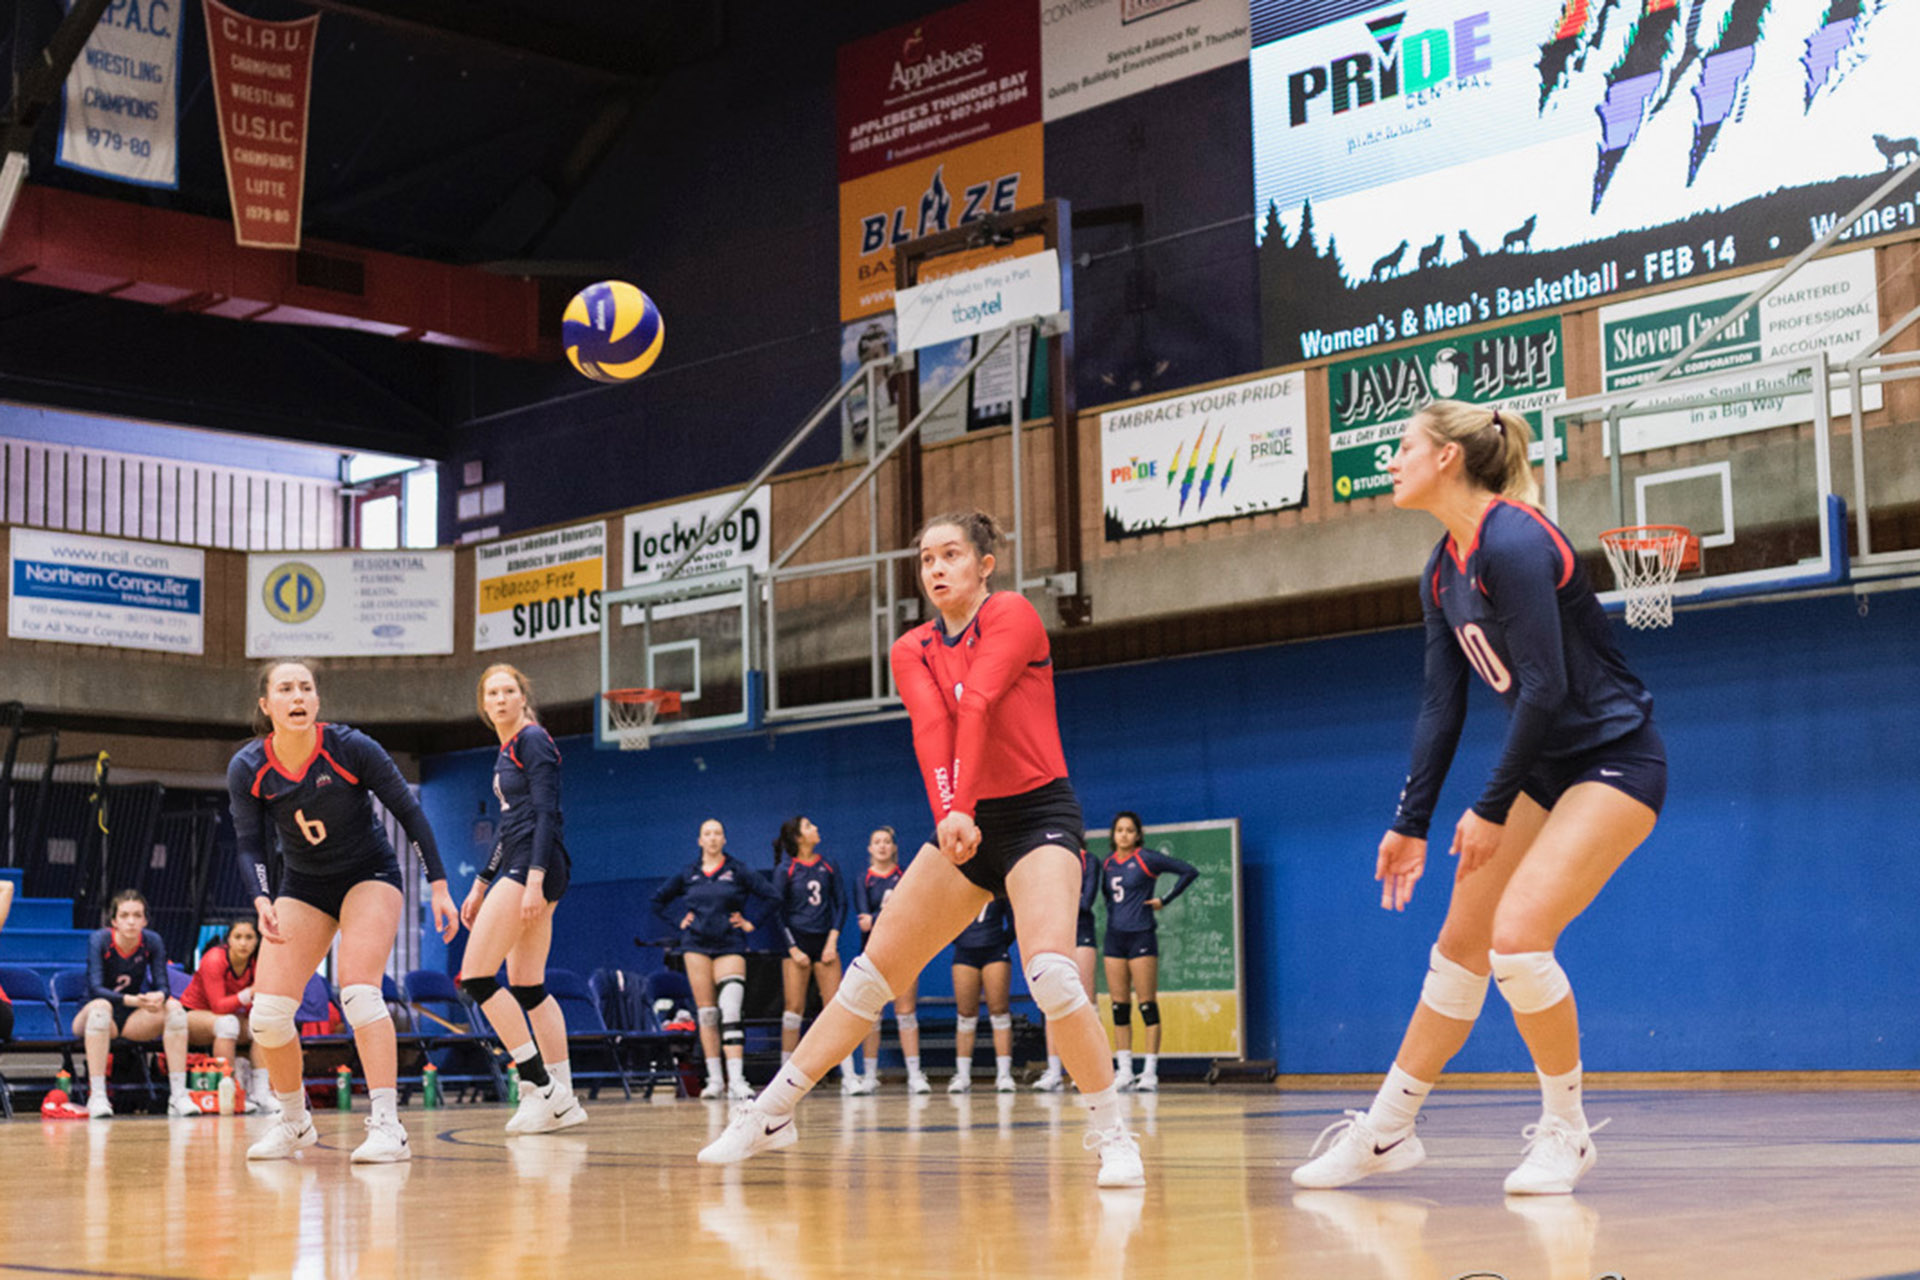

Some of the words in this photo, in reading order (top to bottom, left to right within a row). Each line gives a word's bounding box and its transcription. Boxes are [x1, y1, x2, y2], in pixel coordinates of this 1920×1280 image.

[1106, 47, 1142, 64] Service
[1144, 31, 1184, 52] Alliance
[1186, 24, 1200, 38] for
[85, 47, 163, 84] WRESTLING
[230, 53, 293, 79] CHAMPIONS
[1048, 81, 1079, 99] Quality
[1081, 67, 1120, 88] Building
[1122, 46, 1190, 74] Environments
[1193, 40, 1203, 51] in
[1205, 26, 1248, 47] Thunder
[1288, 11, 1492, 128] PRIDE
[84, 86, 159, 121] CHAMPIONS
[231, 82, 295, 109] WRESTLING
[931, 81, 998, 112] THUNDER
[1000, 70, 1028, 91] BAY
[86, 130, 151, 158] 1979-80
[872, 126, 907, 147] ALLOY
[908, 113, 943, 135] DRIVE
[233, 147, 295, 171] CHAMPIONS
[245, 177, 286, 199] LUTTE
[861, 163, 1021, 257] BLAZE
[952, 291, 1003, 325] tbaytel
[1300, 313, 1396, 360] Women's
[1400, 307, 1419, 337] &
[1423, 291, 1491, 333] Men's
[1496, 259, 1620, 317] Basketball
[1643, 245, 1695, 284] FEB
[1701, 235, 1737, 269] 14
[1767, 280, 1851, 308] CHARTERED
[1769, 303, 1873, 333] PROFESSIONAL
[1613, 325, 1684, 363] Steven
[1770, 329, 1862, 357] ACCOUNTANT
[1335, 354, 1434, 425] JAVA
[1473, 329, 1557, 398] HUT
[1684, 352, 1753, 374] CORPORATION
[1108, 401, 1184, 432] EMBRACE
[1190, 390, 1238, 414] YOUR
[1241, 379, 1292, 404] PRIDE
[1691, 410, 1705, 424] in
[1722, 400, 1748, 418] Big
[1250, 437, 1293, 462] PRIDE
[1335, 431, 1352, 446] ALL
[1355, 428, 1375, 443] DAY
[1111, 456, 1157, 484] PRIDE
[561, 525, 603, 543] University
[51, 547, 169, 569] www.ncil.com
[25, 564, 103, 586] Northern
[107, 572, 189, 596] Computer
[513, 588, 601, 638] sports
[294, 809, 327, 846] 6
[806, 880, 822, 906] 3
[1110, 876, 1125, 903] 5
